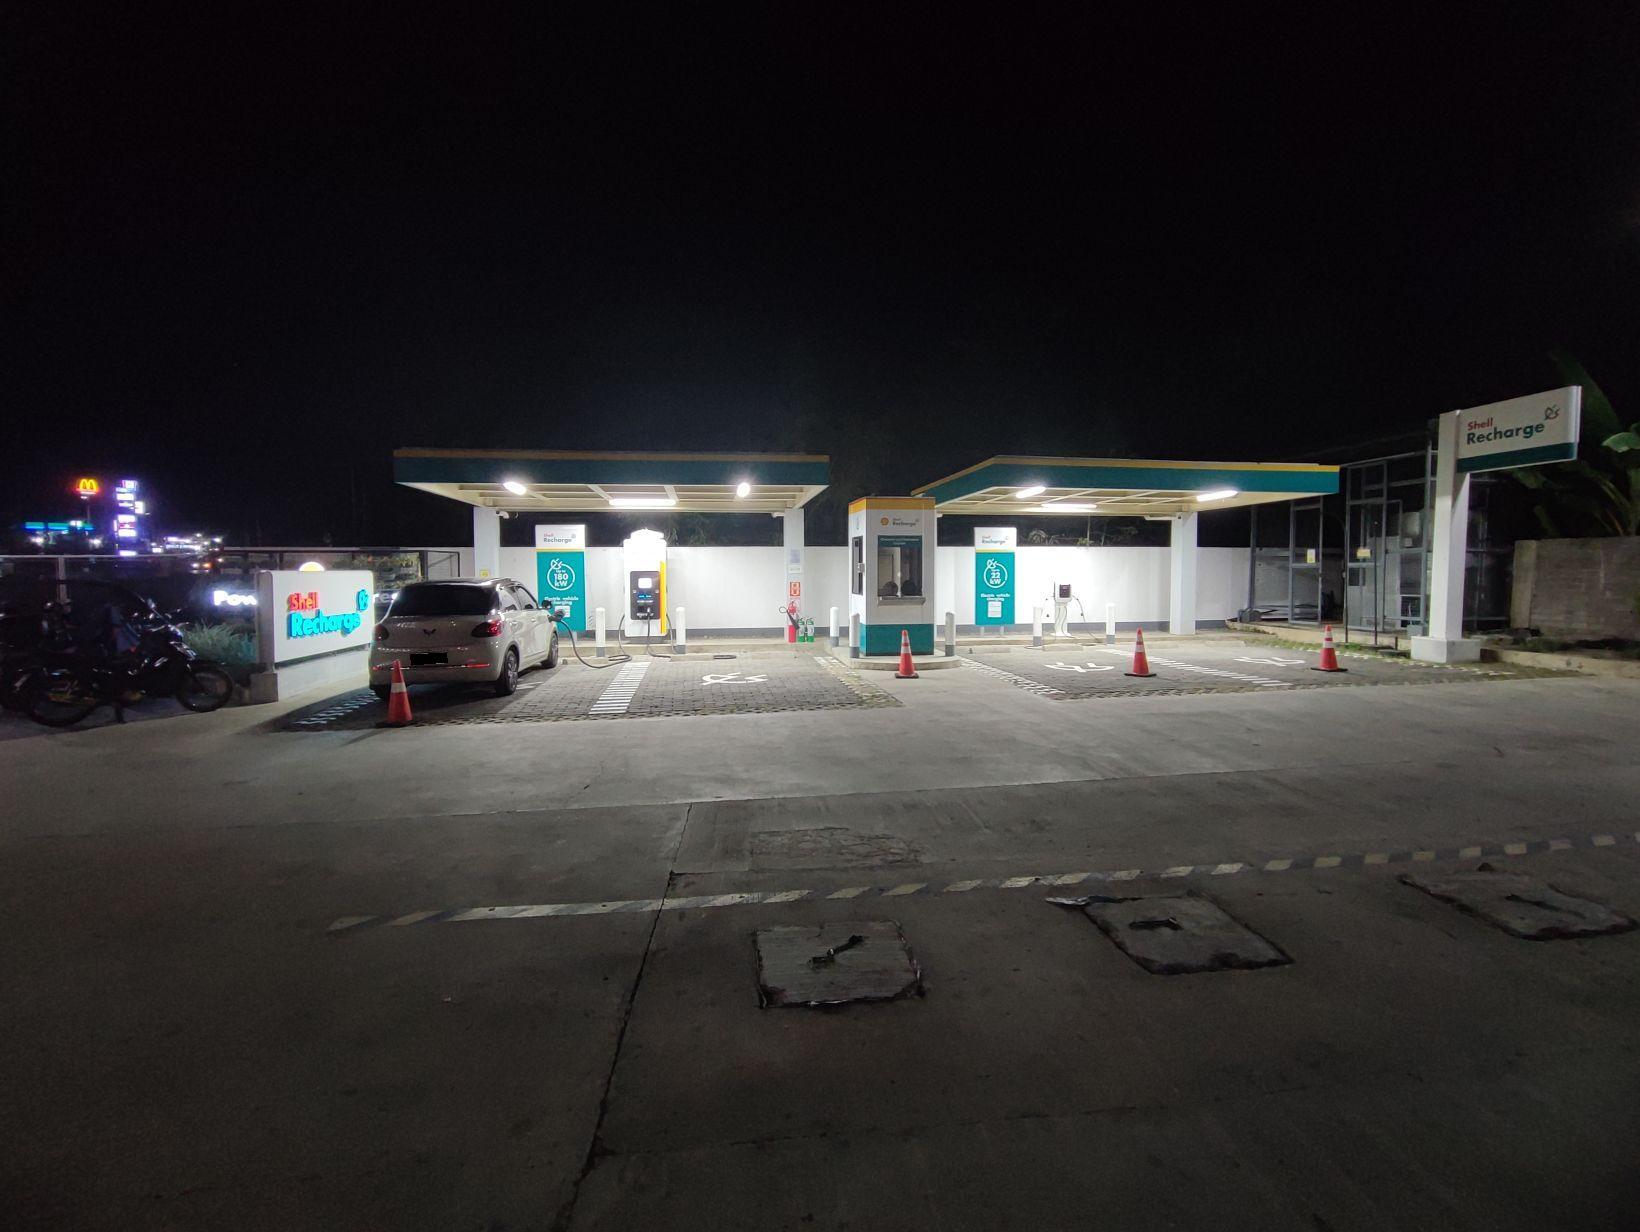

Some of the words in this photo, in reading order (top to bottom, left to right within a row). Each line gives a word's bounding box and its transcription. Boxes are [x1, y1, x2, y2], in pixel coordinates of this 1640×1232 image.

[1466, 422, 1545, 445] Recharge
[1467, 417, 1493, 431] Shell
[288, 591, 319, 611] Shell
[289, 609, 362, 639] Recharge
